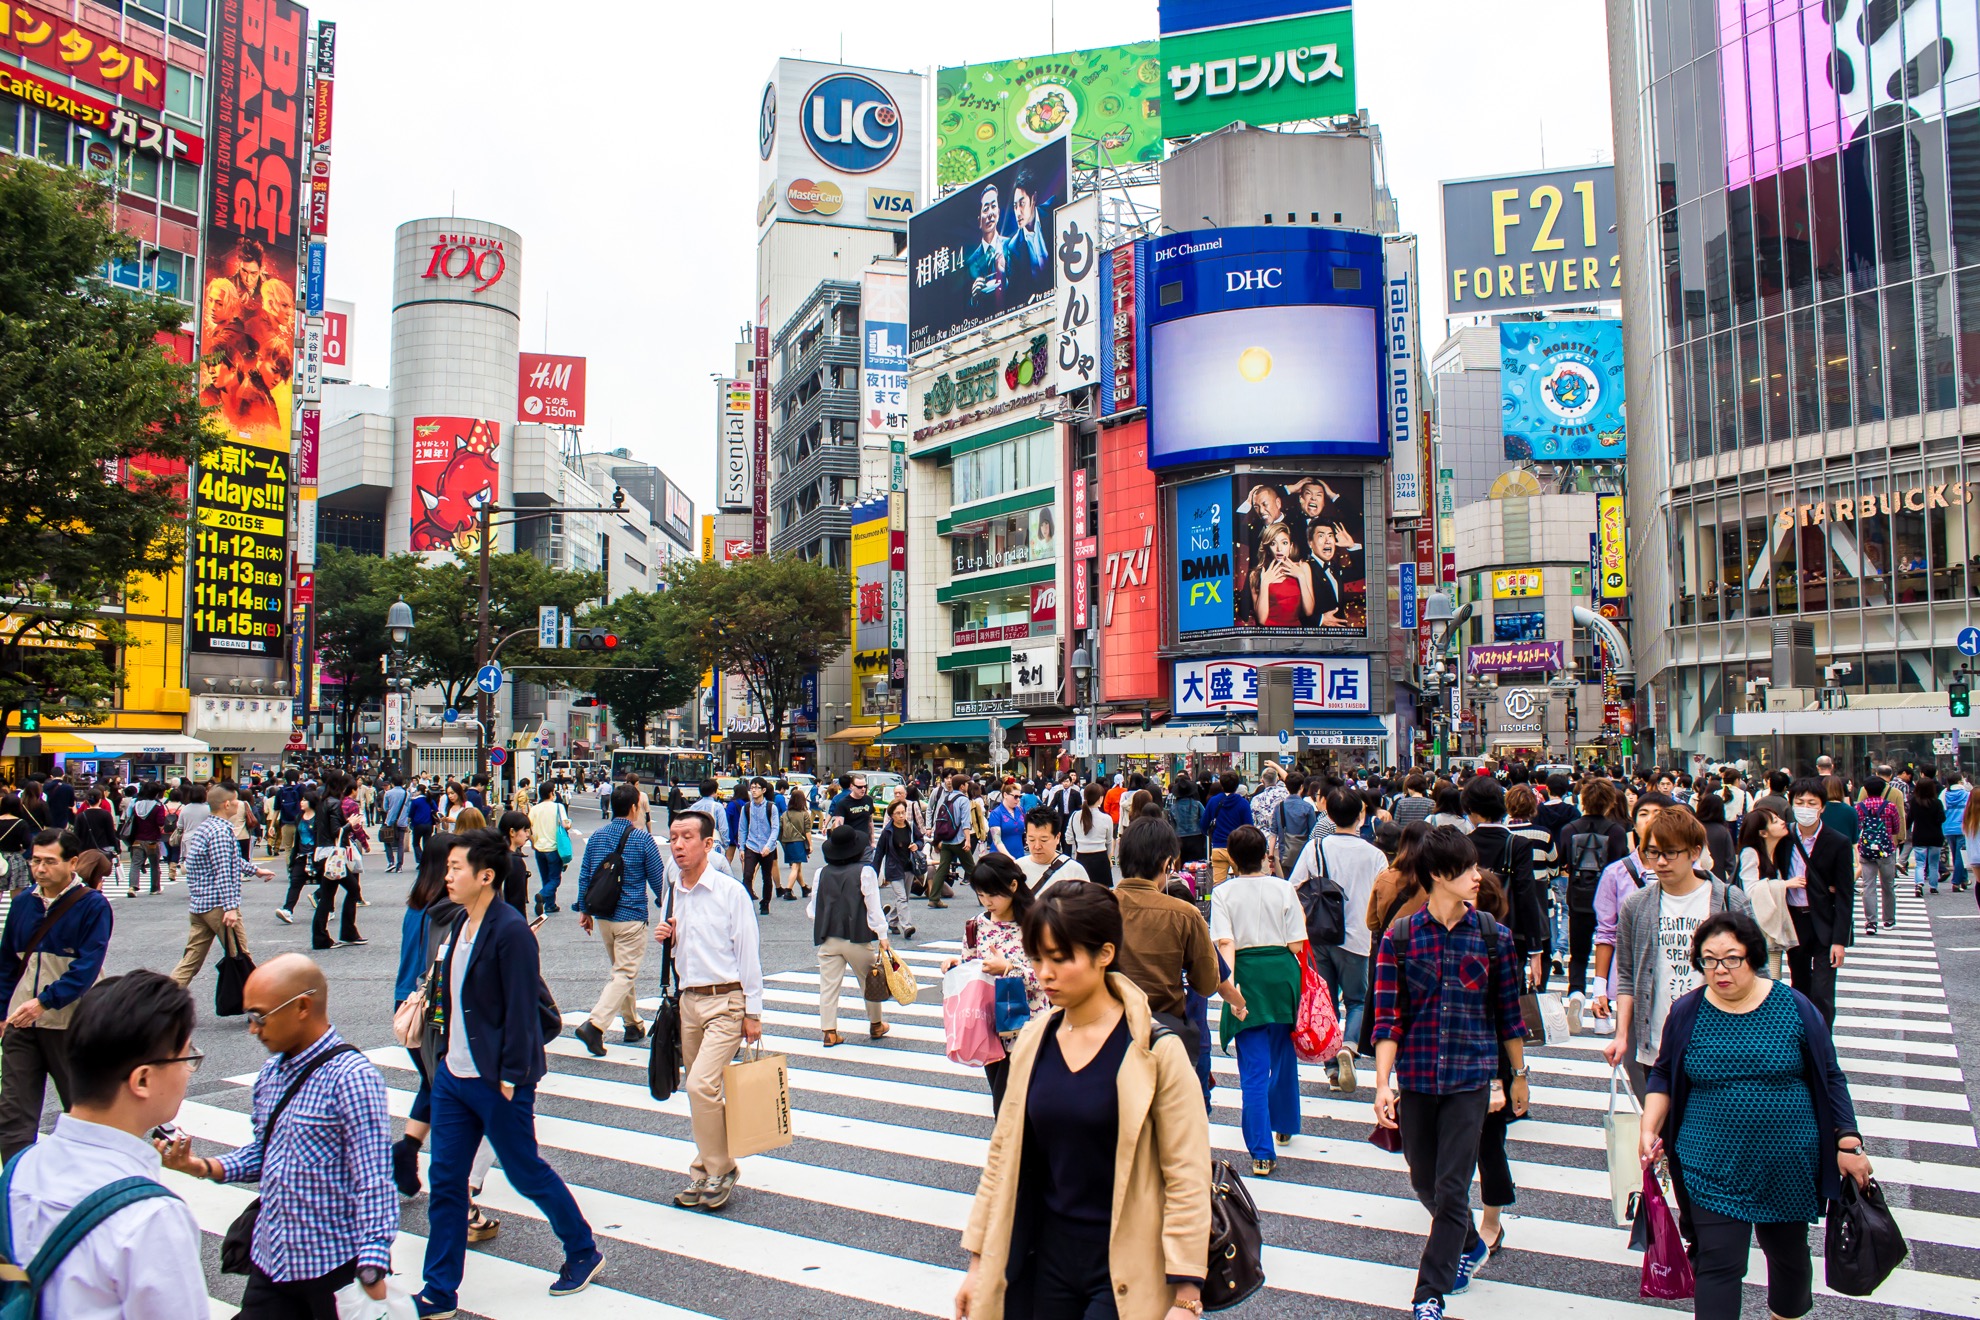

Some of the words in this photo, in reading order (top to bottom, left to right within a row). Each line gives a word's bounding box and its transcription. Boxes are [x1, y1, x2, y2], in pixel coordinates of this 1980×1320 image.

[223, 26, 236, 59] TOUR
[1015, 63, 1079, 87] MONSTER
[1167, 43, 1343, 101] サロンパス
[110, 109, 188, 159] ガスト
[217, 172, 230, 187] IN
[215, 188, 228, 229] JAPAN
[313, 191, 326, 226] ガスト
[788, 189, 842, 204] MasterCard
[873, 195, 914, 213] VISA
[1491, 180, 1597, 256] F21
[439, 234, 504, 251] SHIBUYA
[1155, 247, 1177, 262] DHC
[1179, 238, 1222, 255] Channel
[311, 250, 322, 309] 英会話イーオン
[421, 243, 506, 293] 109
[1226, 268, 1282, 292] DHC
[1453, 257, 1600, 301] FOREVER
[1036, 293, 1042, 302] tv
[1058, 221, 1094, 381] もんじゃ
[1112, 249, 1131, 401] 三千里薬品
[1389, 271, 1411, 360] Taisei
[911, 325, 929, 340] START
[1542, 341, 1599, 358] MONSTER
[1549, 351, 1594, 366] ありがとう!
[306, 331, 319, 394] 渋谷駅前ビル
[530, 362, 572, 392] H&M
[545, 397, 569, 406] この先
[875, 390, 900, 405] まで
[1393, 368, 1409, 442] neon
[545, 405, 577, 418] 150m
[1551, 423, 1596, 436] STRIKE
[415, 440, 449, 448] ありがとう!
[415, 449, 449, 459] 2周年!
[1248, 445, 1270, 454] DHC
[199, 445, 287, 482] 東京ドーム
[725, 412, 744, 504] Essential
[1396, 473, 1414, 482] (03)
[1396, 482, 1416, 490] 3719
[198, 472, 285, 512] 4days!!!
[1396, 490, 1416, 498] 2468
[1075, 474, 1084, 535] お好み焼
[1211, 504, 1221, 524] 2
[1779, 481, 1974, 531] STARBUCKS
[219, 513, 264, 530] 2015年
[196, 530, 283, 561] 11月12日(木)
[854, 530, 880, 541] Matsumoto
[1191, 534, 1212, 551] No.
[956, 545, 1028, 572] Euphoria
[1182, 553, 1230, 581] DMM
[195, 556, 282, 587] 11月13日(金)
[1607, 575, 1621, 586] 4F
[194, 582, 282, 612] 11月14日(土)
[859, 581, 884, 624] 薬
[1033, 588, 1056, 614] JTB
[1076, 563, 1085, 625] もんじゃ焼
[1190, 580, 1222, 606] FX
[1403, 566, 1413, 625] 大盛堂商事ビル
[193, 609, 281, 638] 11月15日(日)
[980, 630, 1001, 641] 海外旅行
[213, 639, 246, 648] BIGBANG
[956, 632, 976, 643] 国内旅行
[1478, 648, 1550, 665] バスケットボールストリート
[1500, 723, 1541, 732] ITS'DEMO
[1677, 934, 1688, 946] DO
[1671, 963, 1690, 976] YOU
[780, 1090, 789, 1135] union
